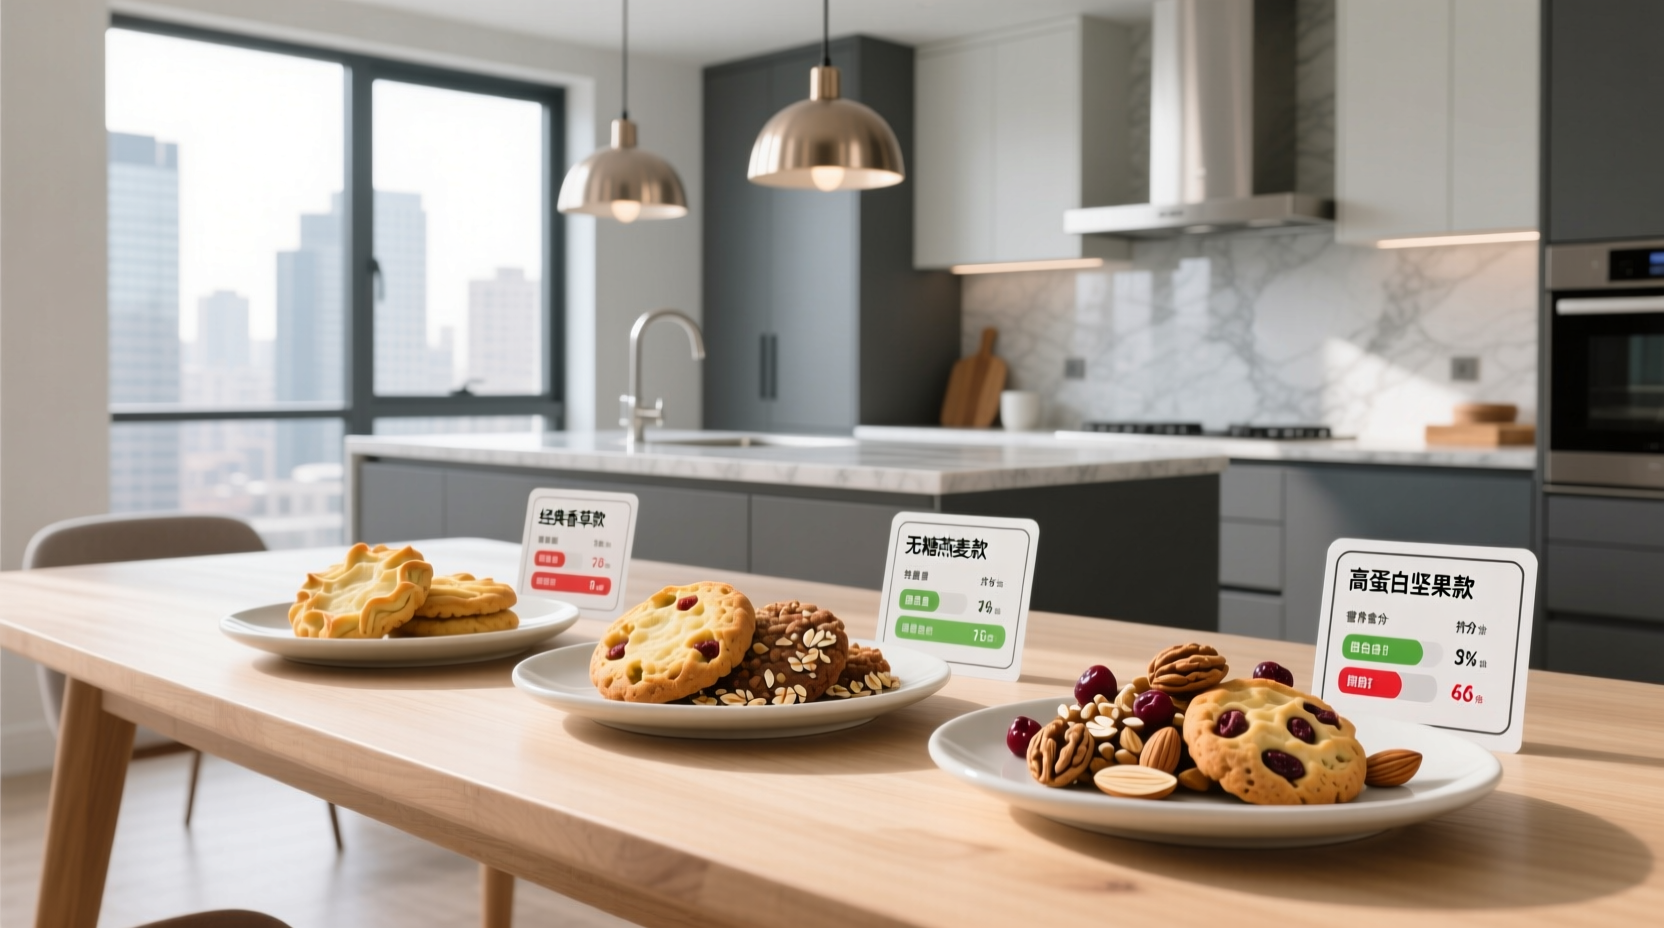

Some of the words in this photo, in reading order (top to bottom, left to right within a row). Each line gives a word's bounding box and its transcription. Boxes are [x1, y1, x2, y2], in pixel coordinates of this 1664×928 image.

[538, 508, 606, 528] 经典香草款
[905, 535, 988, 560] 无糖燕麦款
[1349, 567, 1475, 600] 高蛋白坚果款
